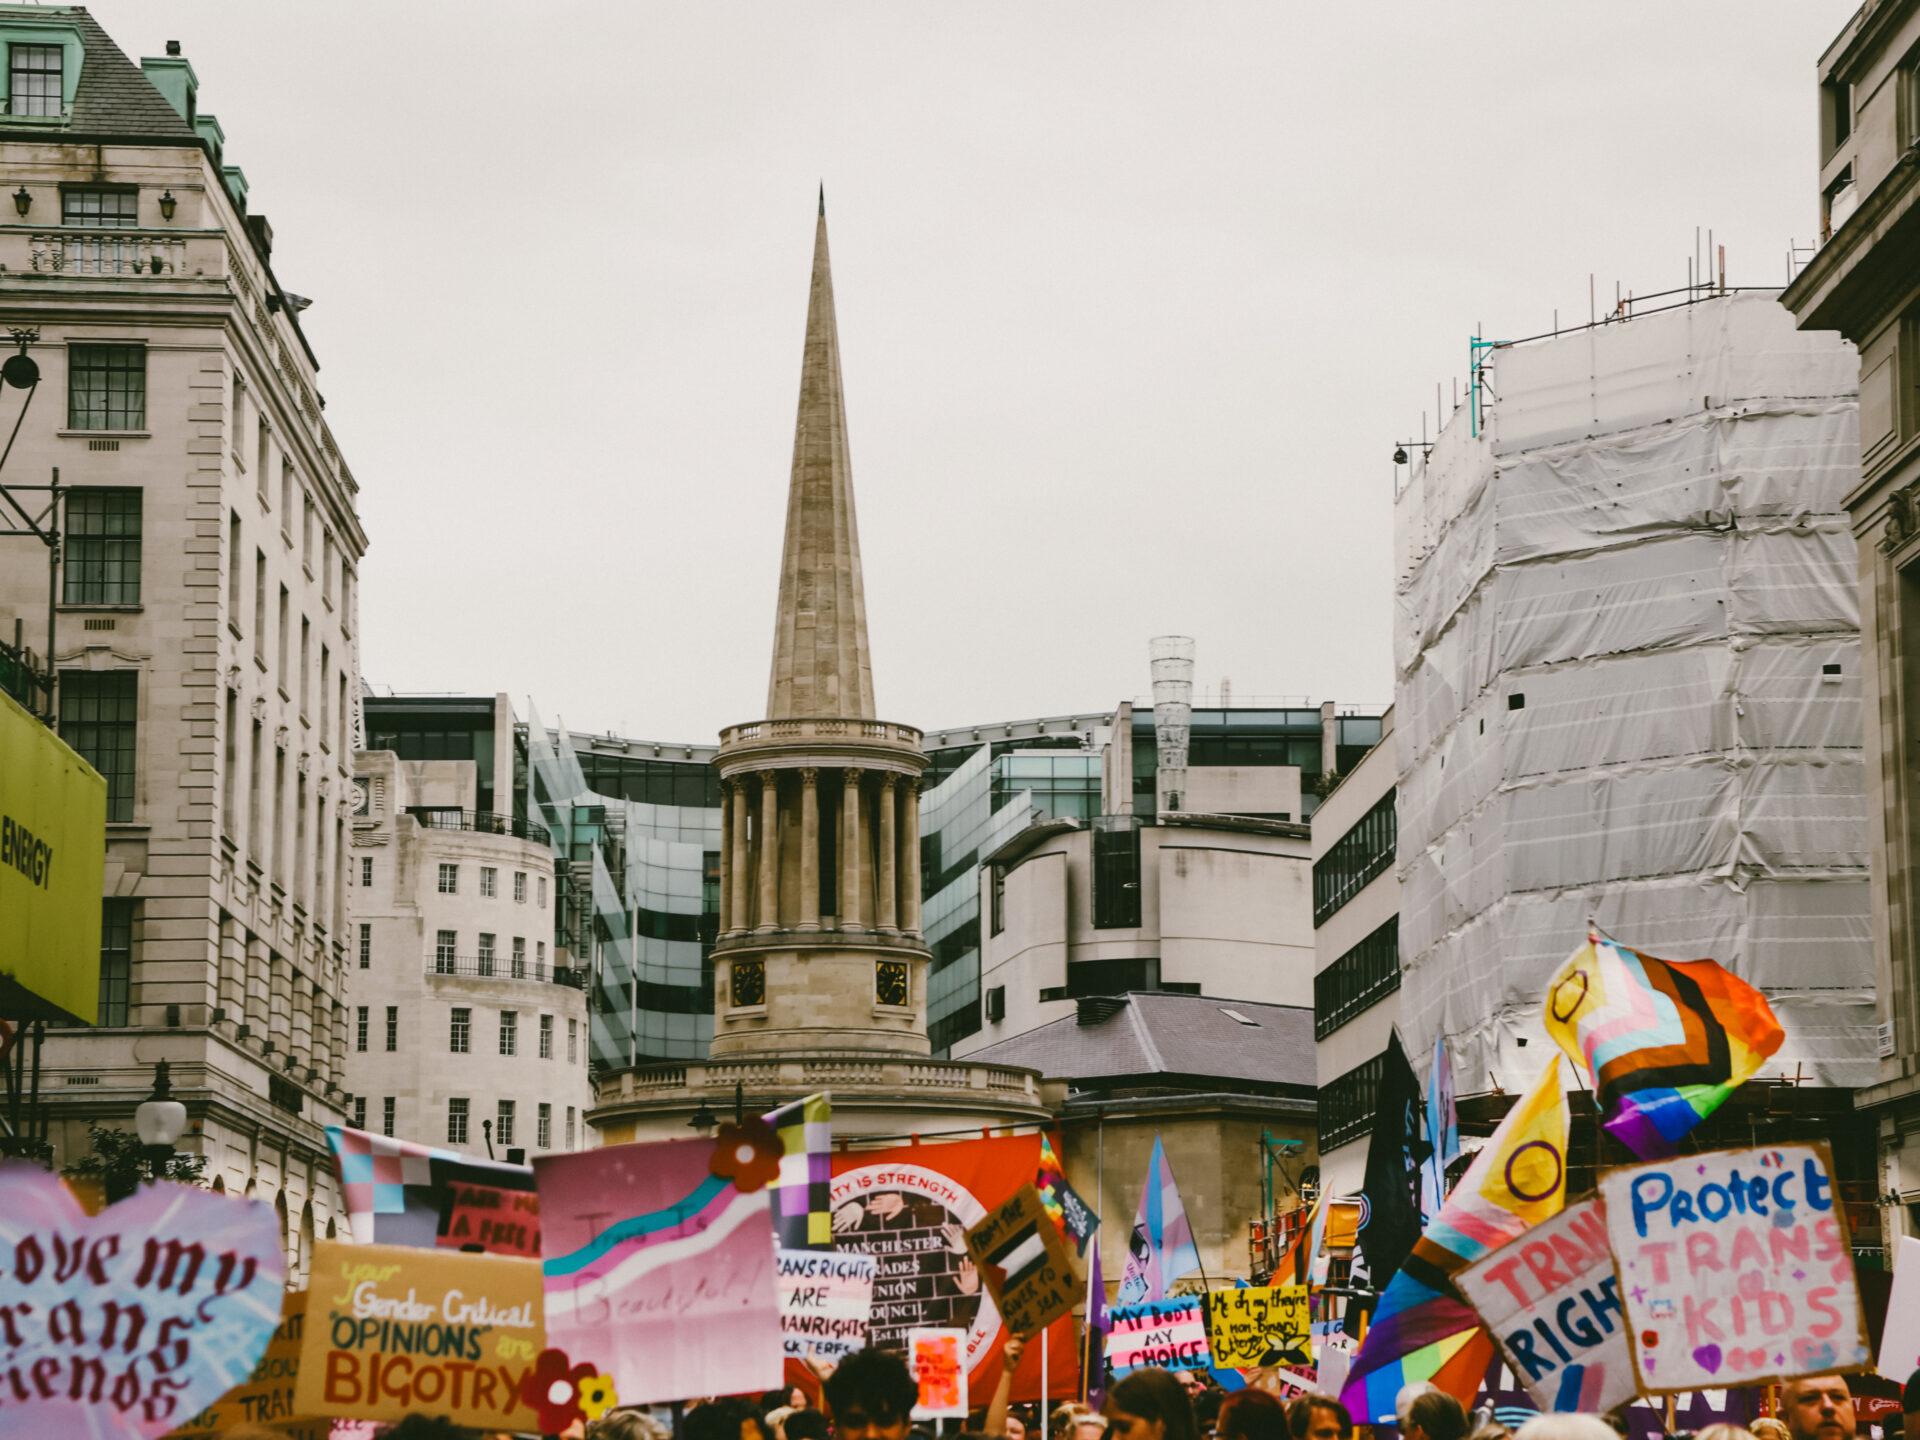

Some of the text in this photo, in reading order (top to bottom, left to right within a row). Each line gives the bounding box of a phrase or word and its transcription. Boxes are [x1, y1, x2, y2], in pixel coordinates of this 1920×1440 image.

[2, 815, 52, 890] ENERGY
[830, 1173, 958, 1204] ITY IS STRENGTH
[836, 1236, 943, 1254] MANCHESTER
[1482, 1195, 1609, 1313] TRAN
[1638, 1218, 1842, 1286] TRANS
[0, 1234, 258, 1324] ove my
[873, 1259, 921, 1278] RADES
[352, 1281, 535, 1327] Gender Critical
[789, 1287, 831, 1307] ARE
[870, 1303, 928, 1320] OUNCIL
[1002, 1267, 1056, 1320] RIVER TO
[1036, 1289, 1064, 1316] SEA
[1110, 1306, 1146, 1333] MY
[1504, 1274, 1622, 1382] RIGH
[1683, 1287, 1842, 1348] KIDS
[0, 1298, 193, 1375] rans
[496, 1335, 536, 1361] are
[784, 1340, 801, 1354] CK
[966, 1328, 986, 1359] BLE
[1144, 1329, 1173, 1346] MY
[0, 1354, 190, 1423] iends
[324, 1350, 533, 1415] BIGOTRY
[238, 1387, 294, 1423] TRA
